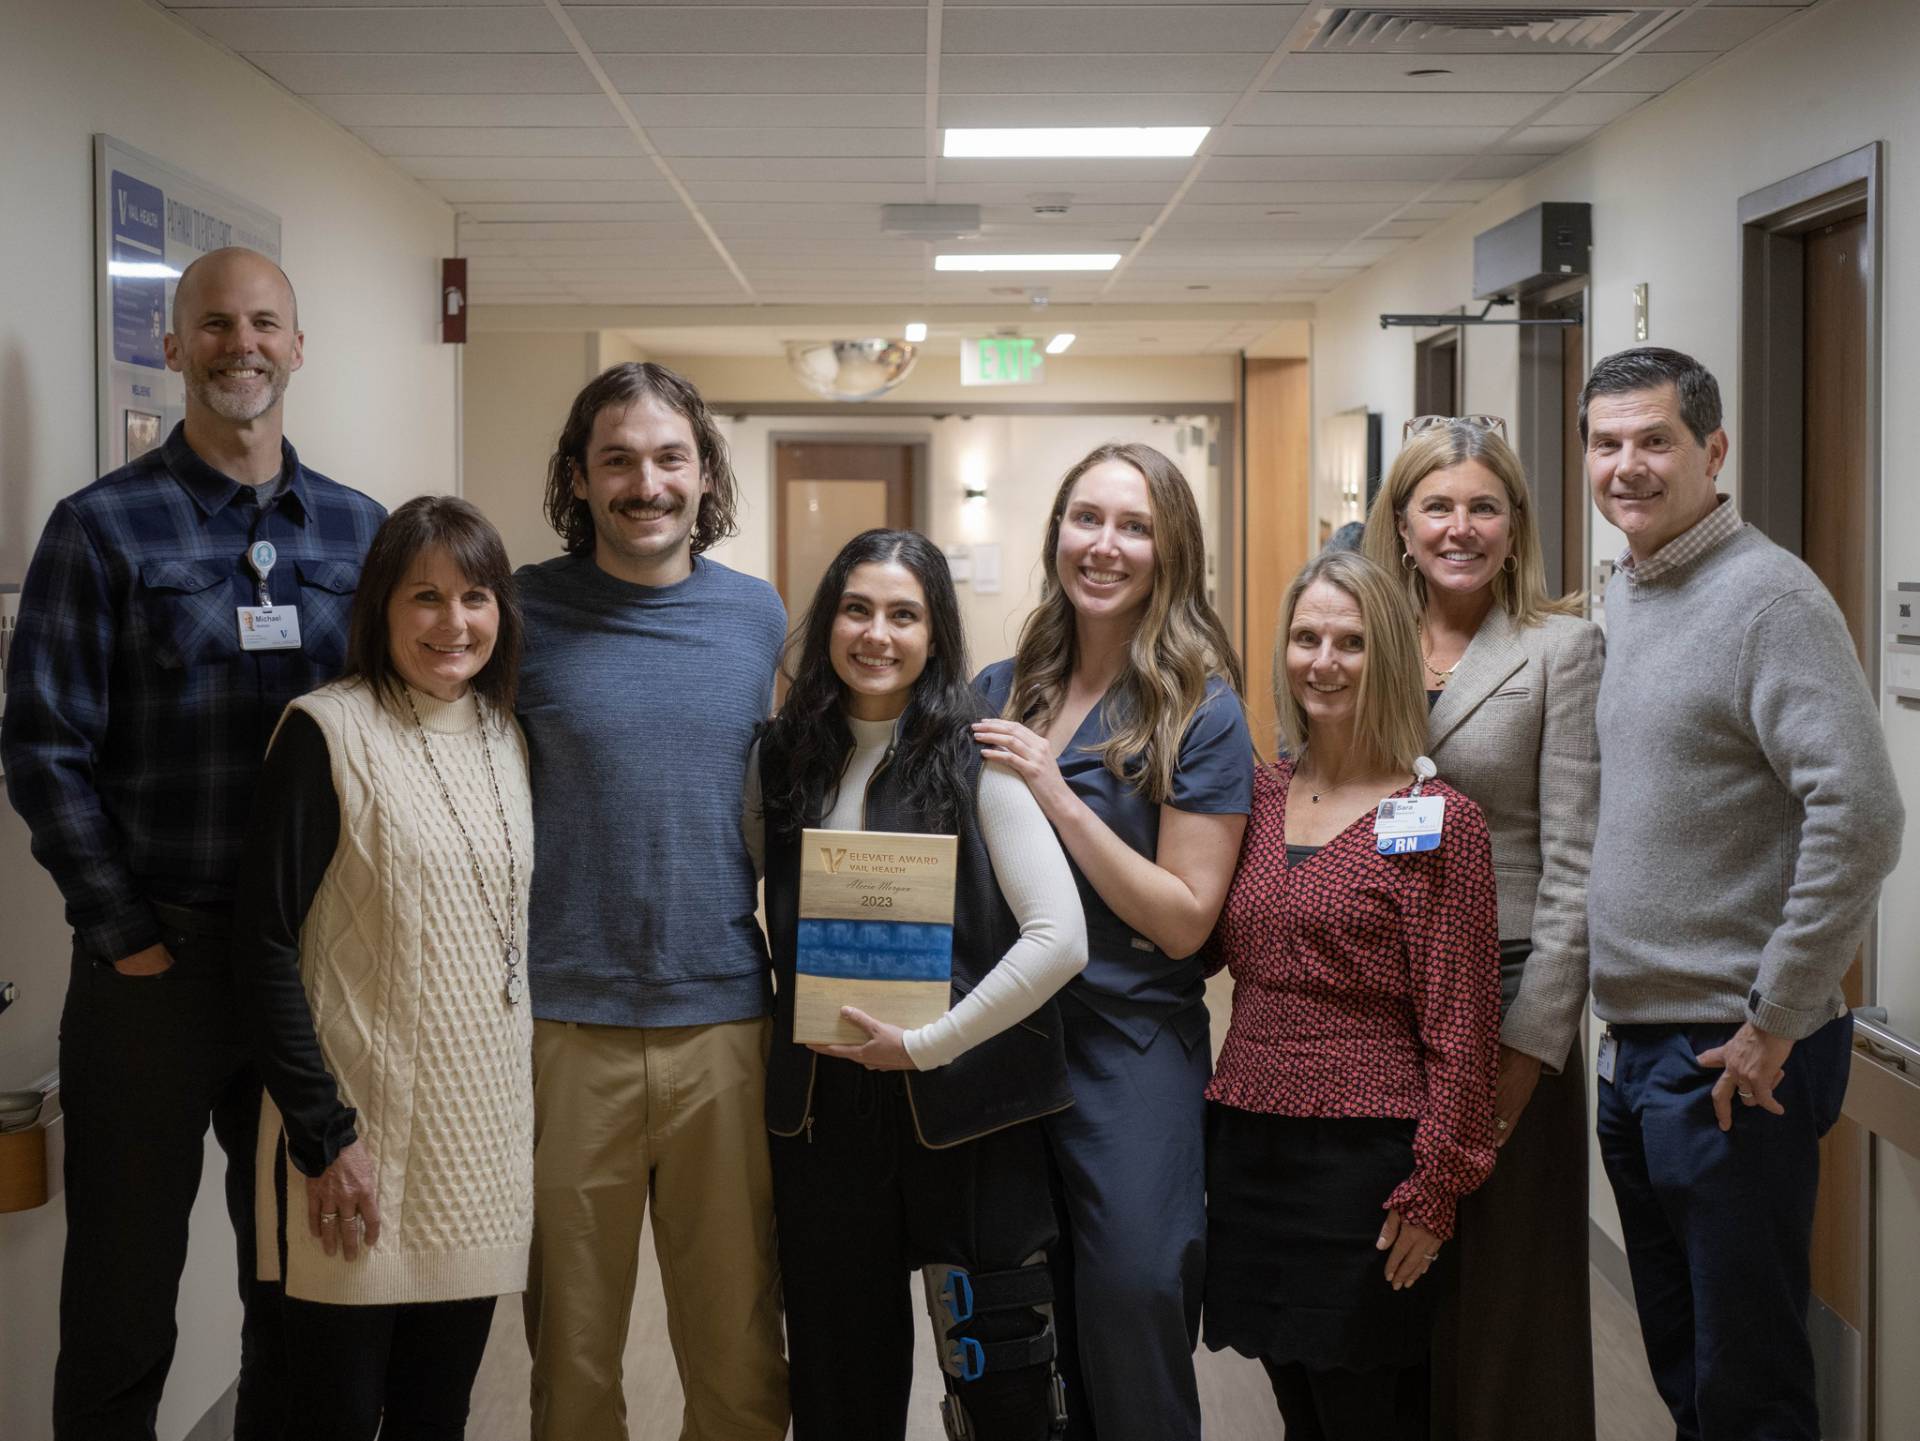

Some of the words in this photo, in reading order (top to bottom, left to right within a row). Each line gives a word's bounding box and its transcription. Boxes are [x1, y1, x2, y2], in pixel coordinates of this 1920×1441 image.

[128, 204, 139, 221] VAIL
[139, 207, 159, 228] HEALTH
[978, 338, 1035, 381] EXIT
[255, 614, 282, 623] Michael
[1394, 836, 1418, 852] RN
[849, 852, 894, 863] ELEVATE
[898, 855, 938, 865] AWARD
[849, 864, 869, 873] VAIL
[872, 865, 906, 874] HEALTH
[879, 880, 912, 895] Morgan
[860, 895, 894, 908] 2023
